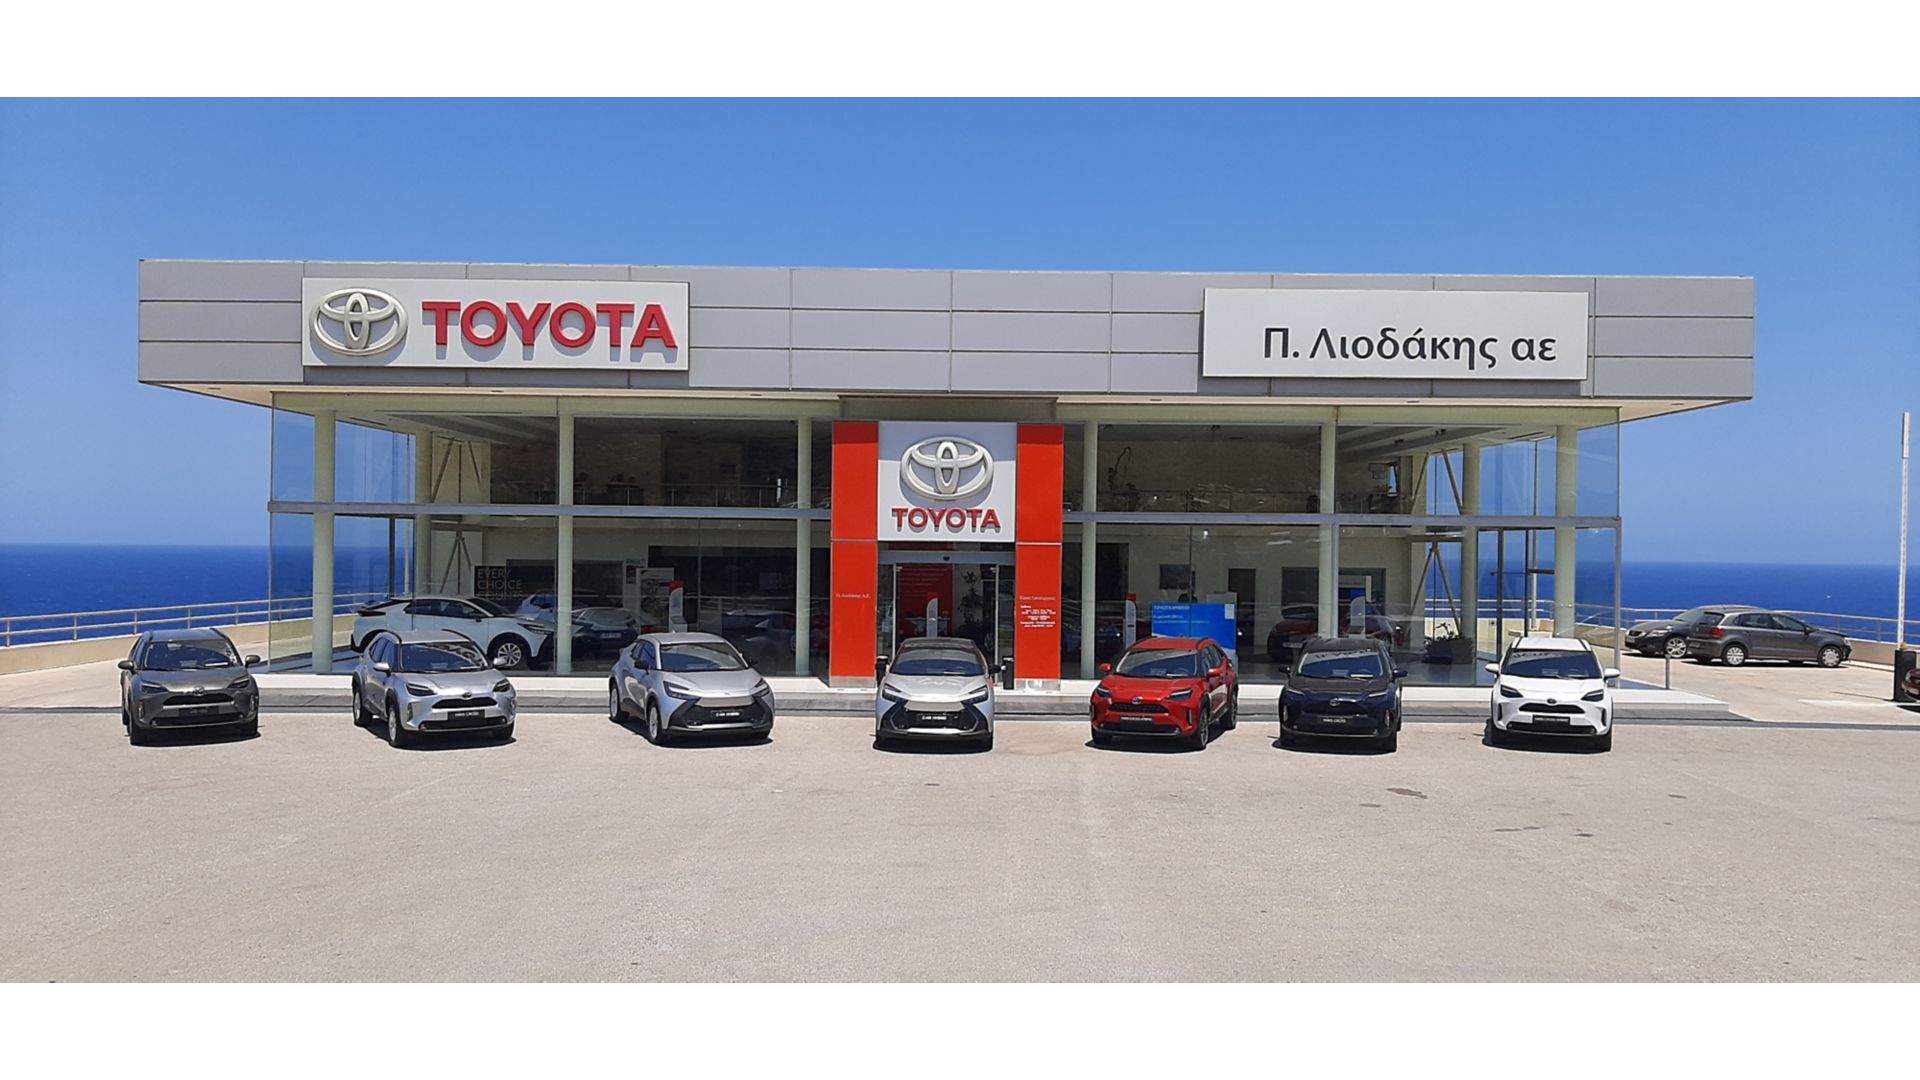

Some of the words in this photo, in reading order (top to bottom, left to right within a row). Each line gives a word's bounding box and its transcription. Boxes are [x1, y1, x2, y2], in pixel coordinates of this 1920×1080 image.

[421, 300, 679, 349] TOYOTA
[1263, 327, 1300, 359] Π.
[1309, 326, 1498, 371] Λιοδάκης
[1511, 337, 1557, 361] αε
[891, 507, 1001, 529] TOYOTA
[477, 568, 511, 579] EVERY
[477, 579, 522, 590] CHOICE
